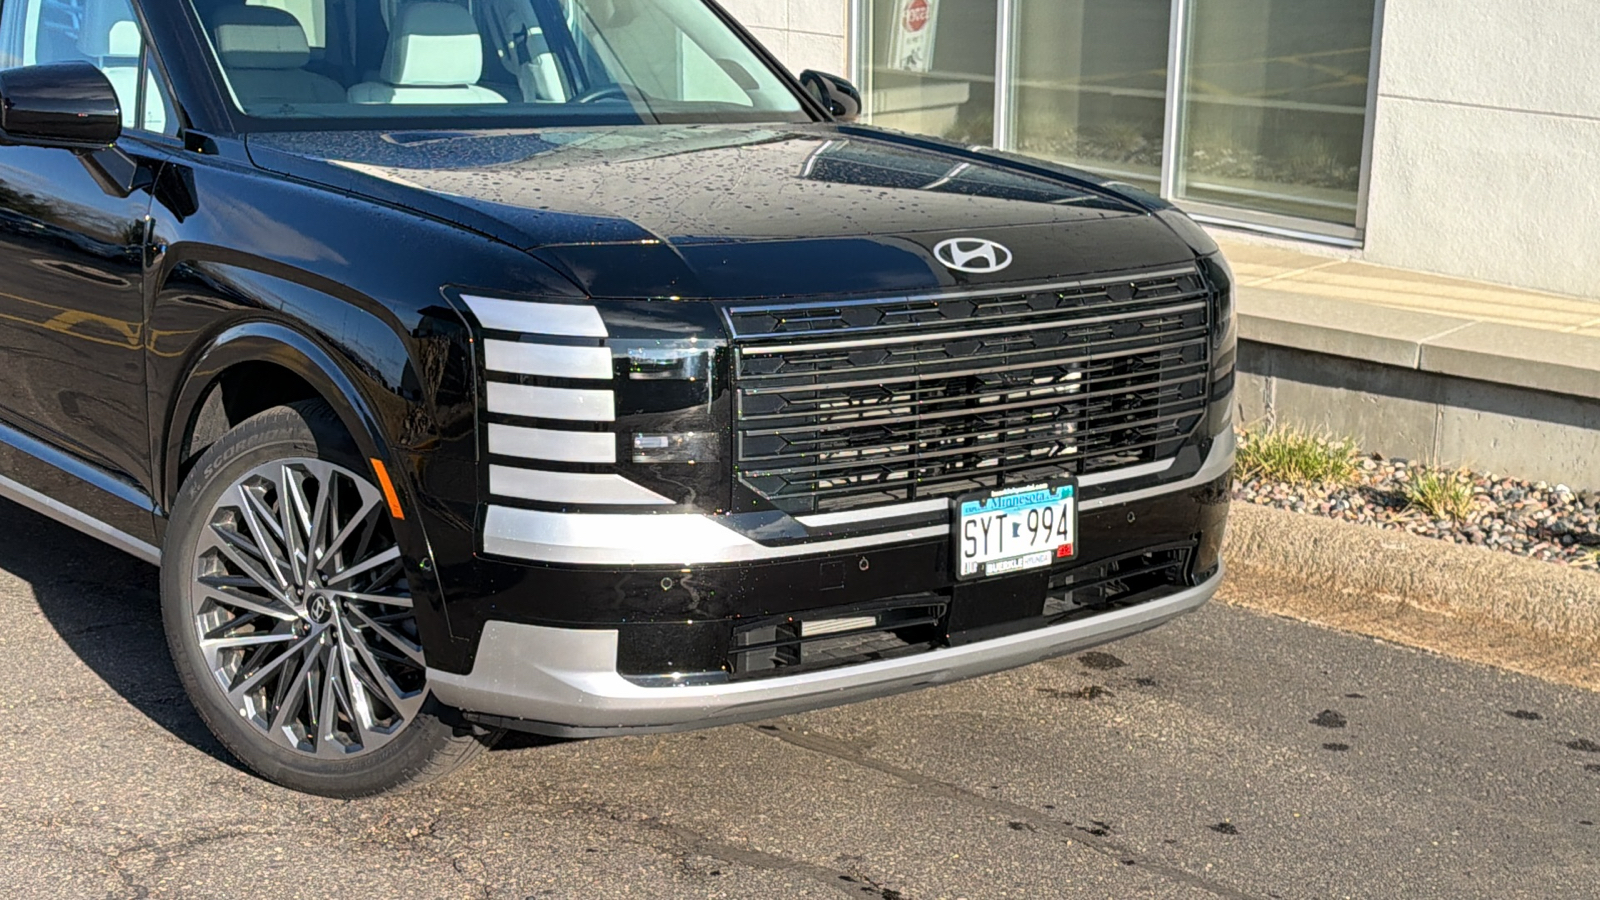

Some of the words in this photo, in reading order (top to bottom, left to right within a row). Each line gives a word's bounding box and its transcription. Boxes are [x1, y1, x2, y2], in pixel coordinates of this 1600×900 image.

[203, 427, 294, 480] SCORPION
[991, 493, 1045, 509] Minnesota
[964, 513, 1008, 558] SYT
[1027, 503, 1068, 546] 994
